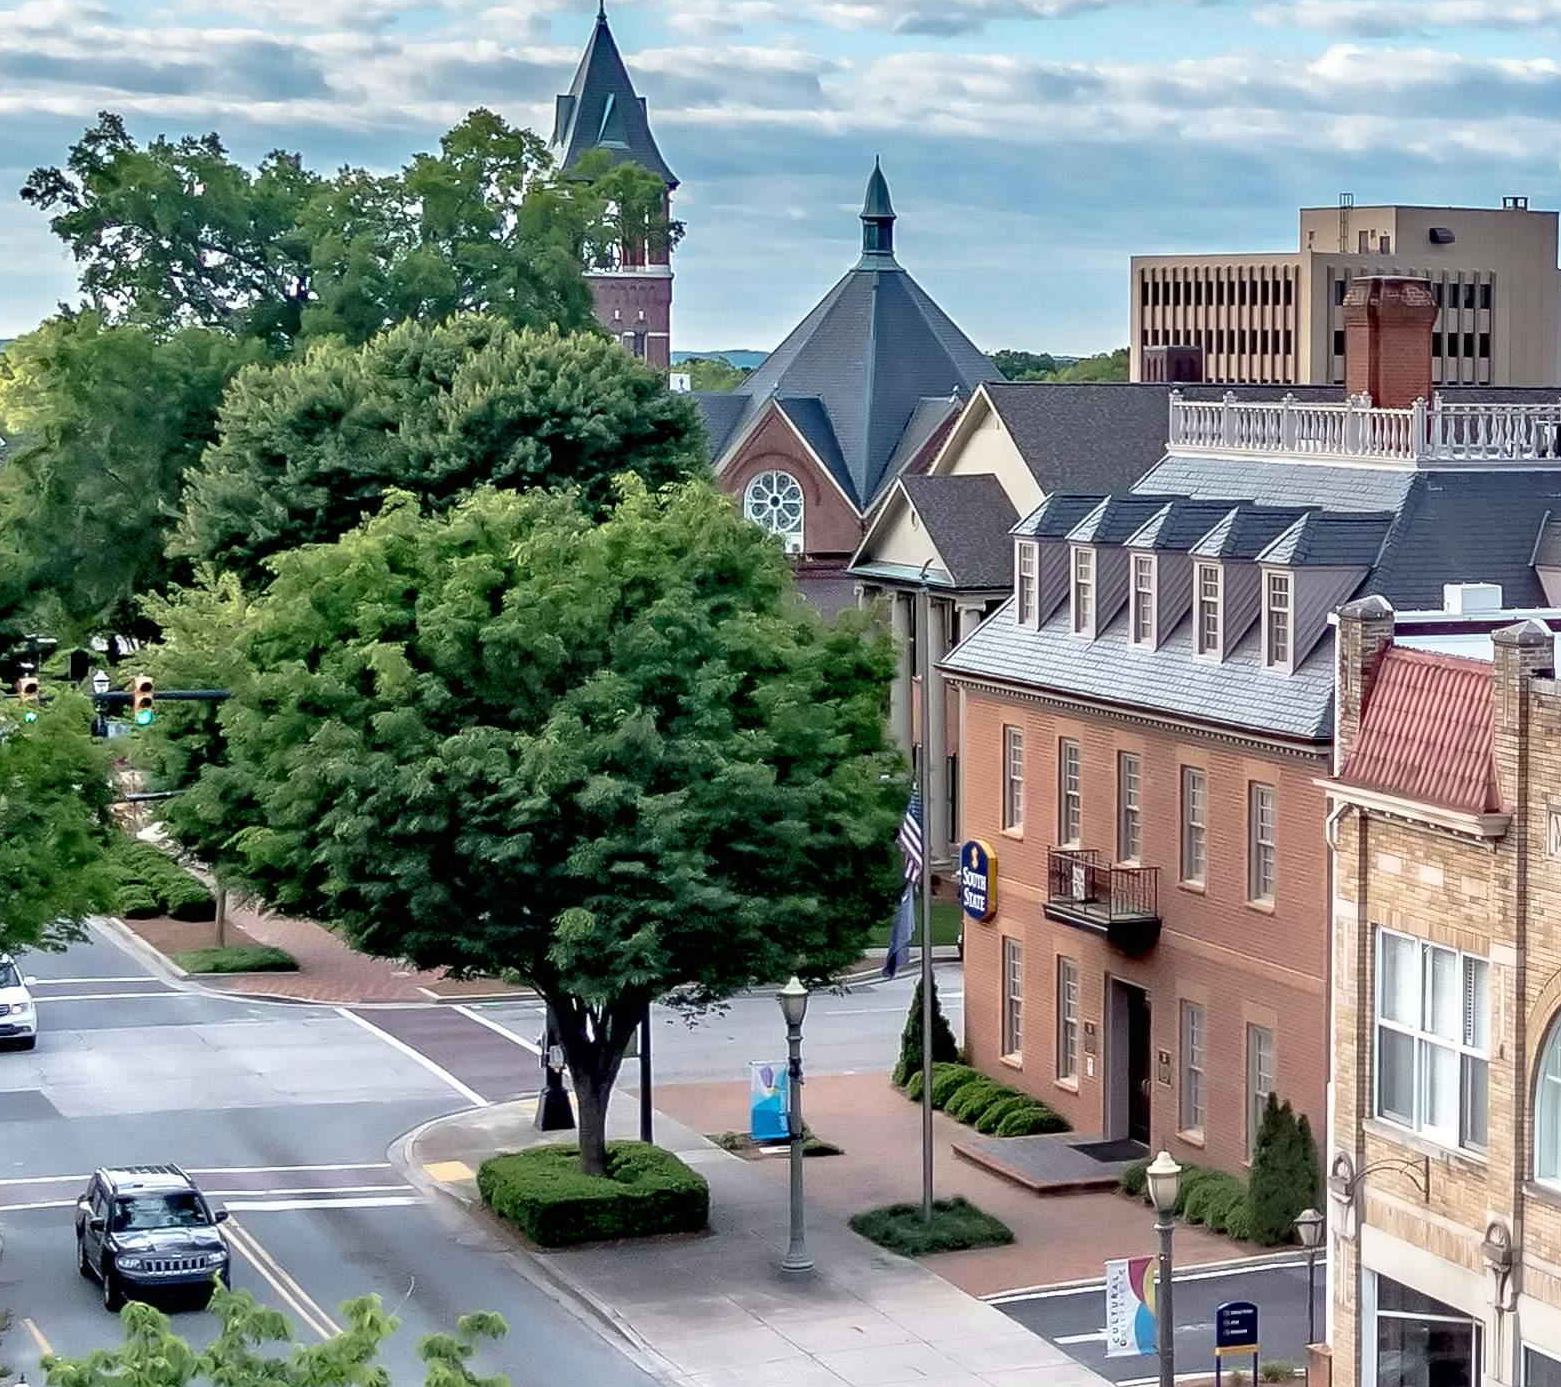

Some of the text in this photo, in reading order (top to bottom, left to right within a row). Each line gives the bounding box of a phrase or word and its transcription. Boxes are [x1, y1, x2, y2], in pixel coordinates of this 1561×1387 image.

[962, 866, 987, 891] SOUTH
[963, 887, 986, 912] STATE
[1111, 1275, 1120, 1344] CULTURAL
